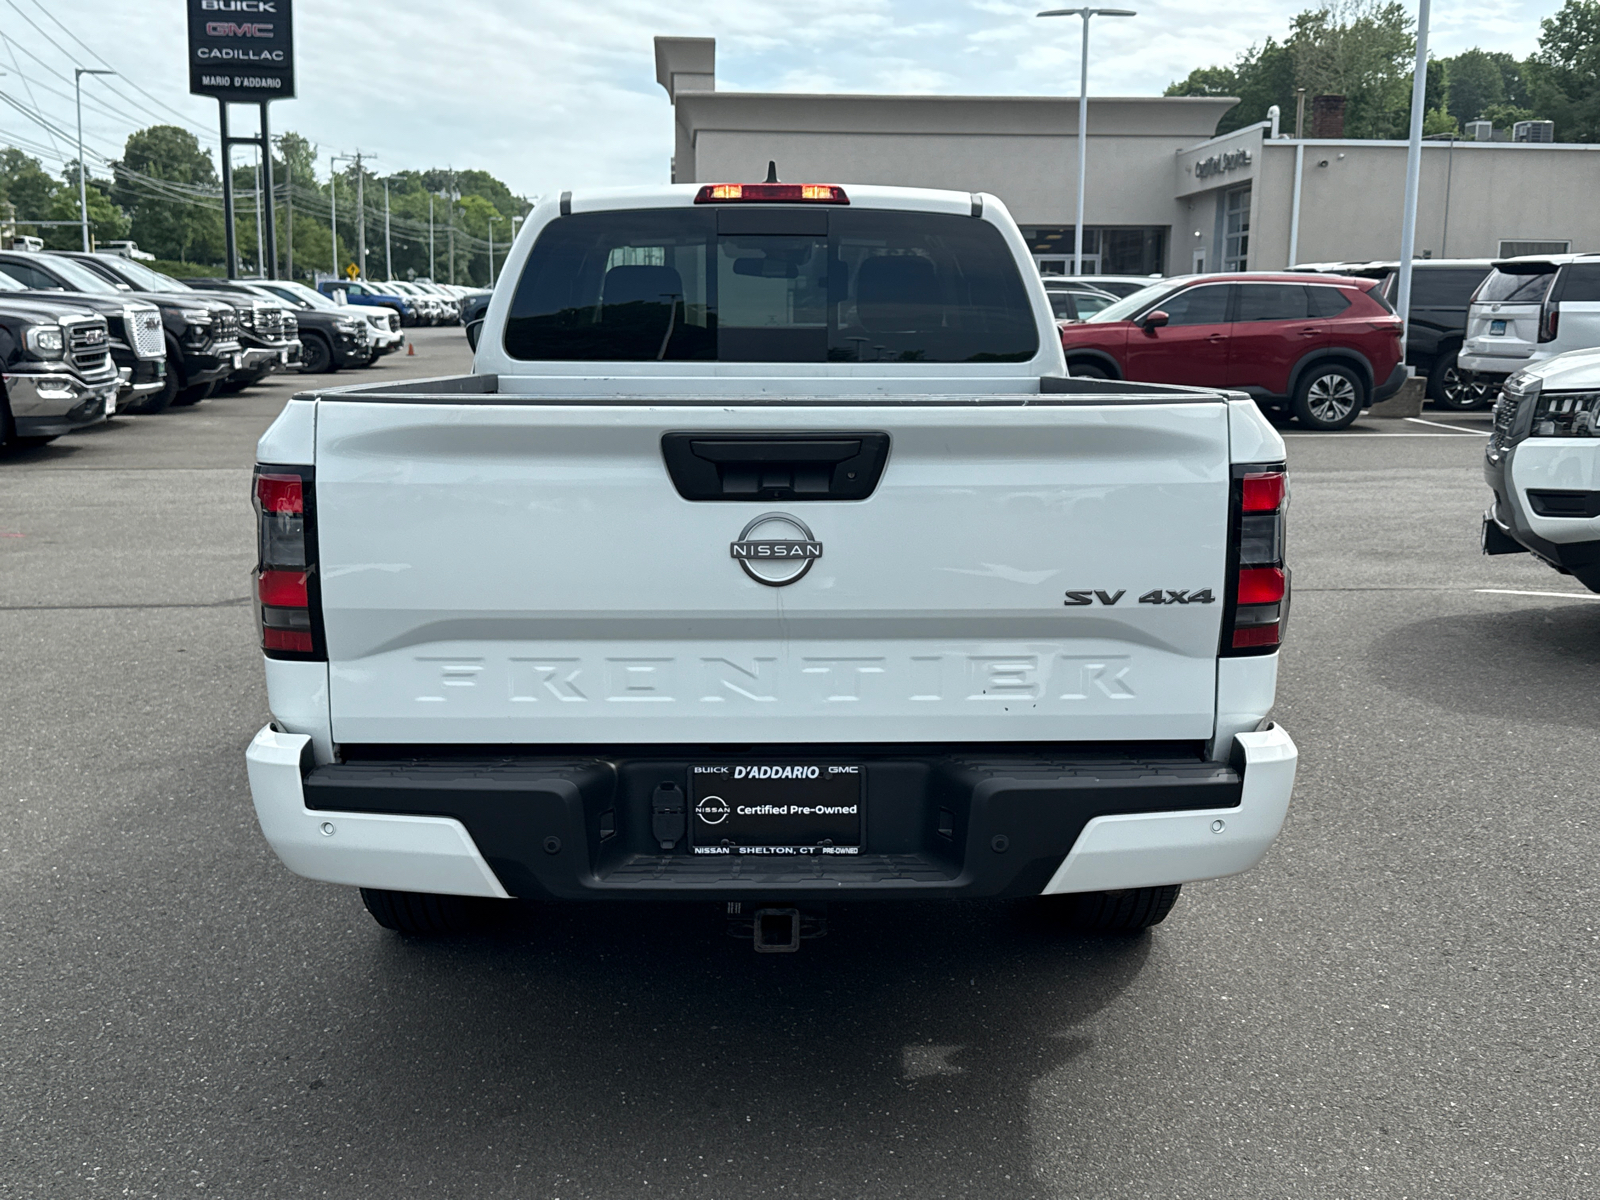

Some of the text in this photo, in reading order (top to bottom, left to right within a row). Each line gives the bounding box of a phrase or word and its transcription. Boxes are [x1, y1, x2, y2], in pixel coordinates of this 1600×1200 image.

[201, 0, 277, 13] BUICK
[206, 22, 274, 38] GMC
[197, 47, 284, 61] CADILLAC
[202, 75, 281, 88] MARIO D'ADDARIO
[733, 544, 820, 556] NISSAN
[1064, 588, 1127, 606] SV
[413, 655, 1136, 702] FRONTIER
[734, 766, 820, 779] D'ADDARIO
[736, 804, 858, 815] Certified Pre-Owned
[739, 847, 796, 855] SHELTON,
[822, 847, 859, 855] PRE-OWNED
